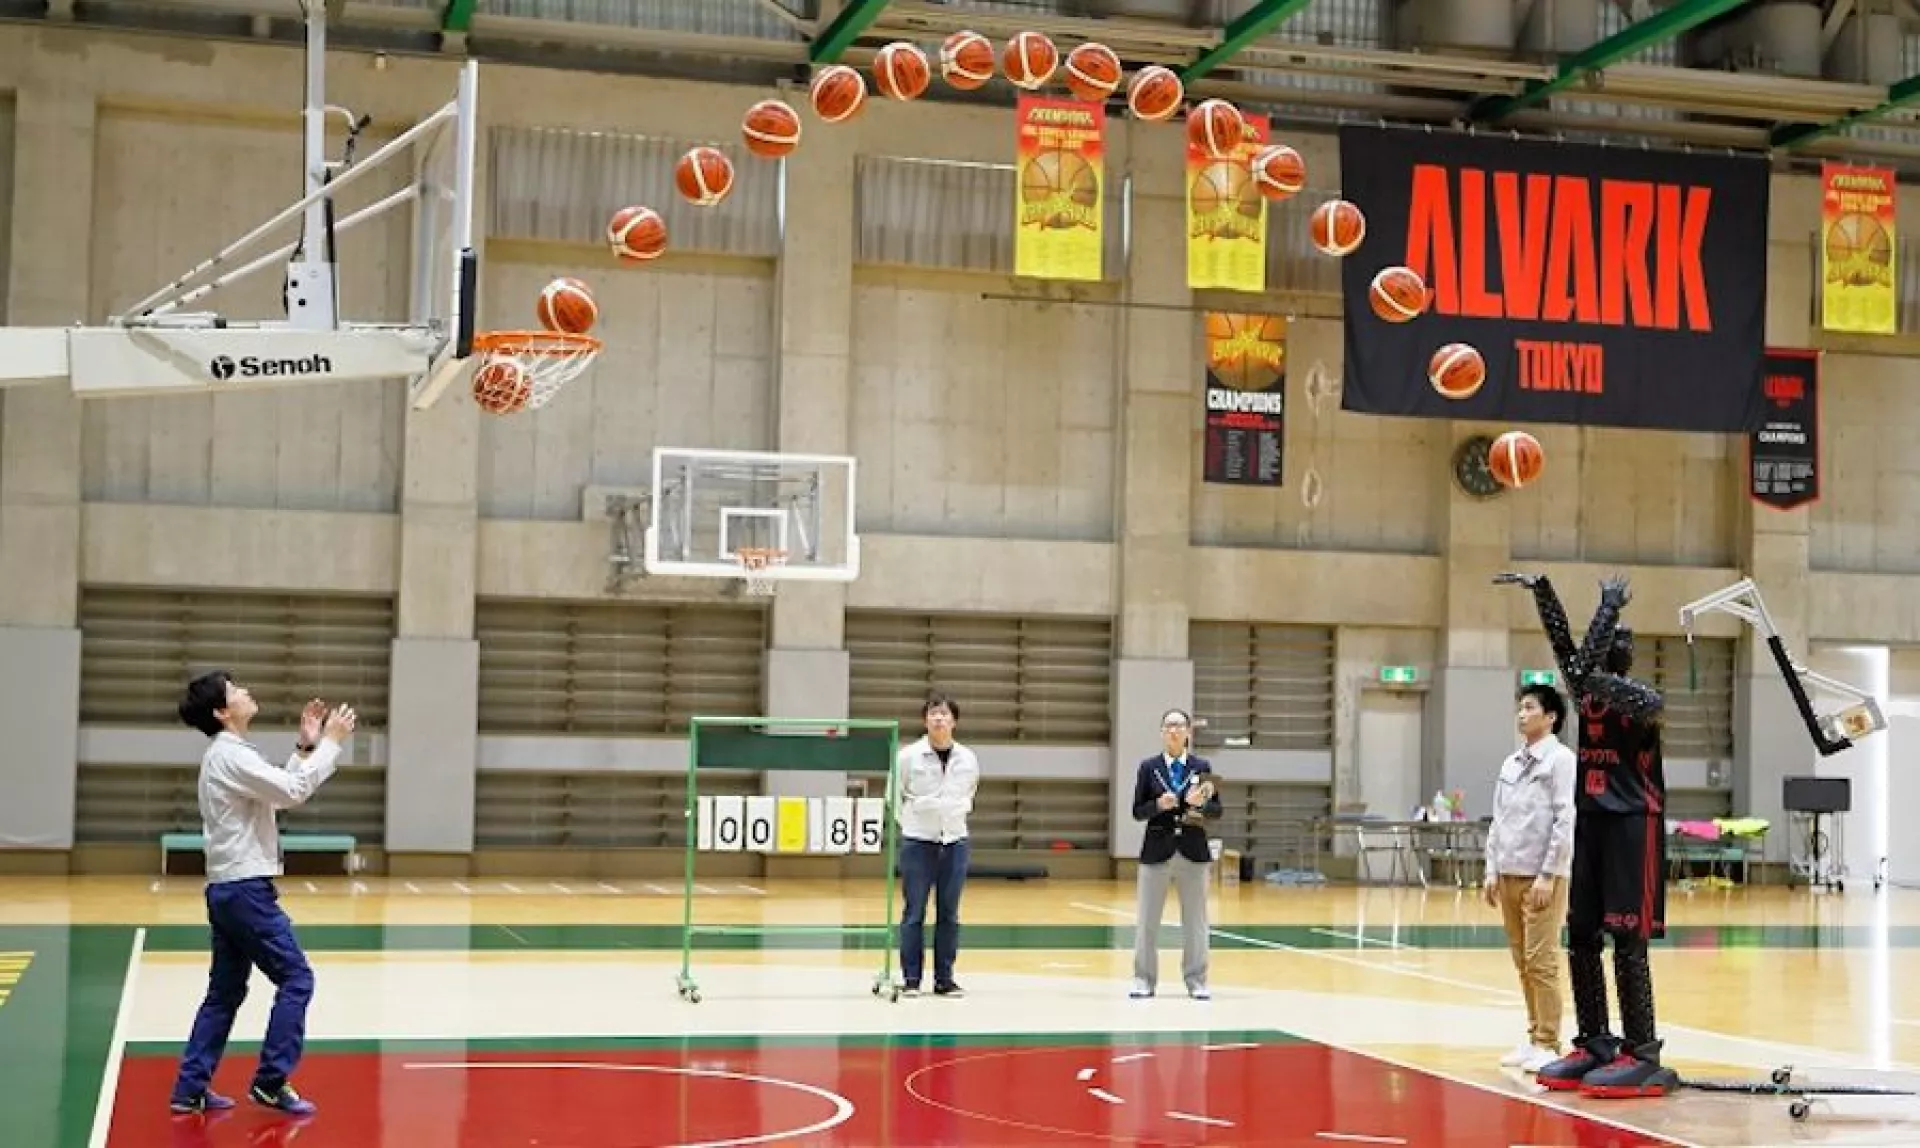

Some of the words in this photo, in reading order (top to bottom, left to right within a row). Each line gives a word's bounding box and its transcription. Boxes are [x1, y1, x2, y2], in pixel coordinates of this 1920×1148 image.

[1405, 164, 1712, 332] ALVARK
[239, 354, 332, 376] Senoh
[1515, 339, 1603, 393] TOKYO
